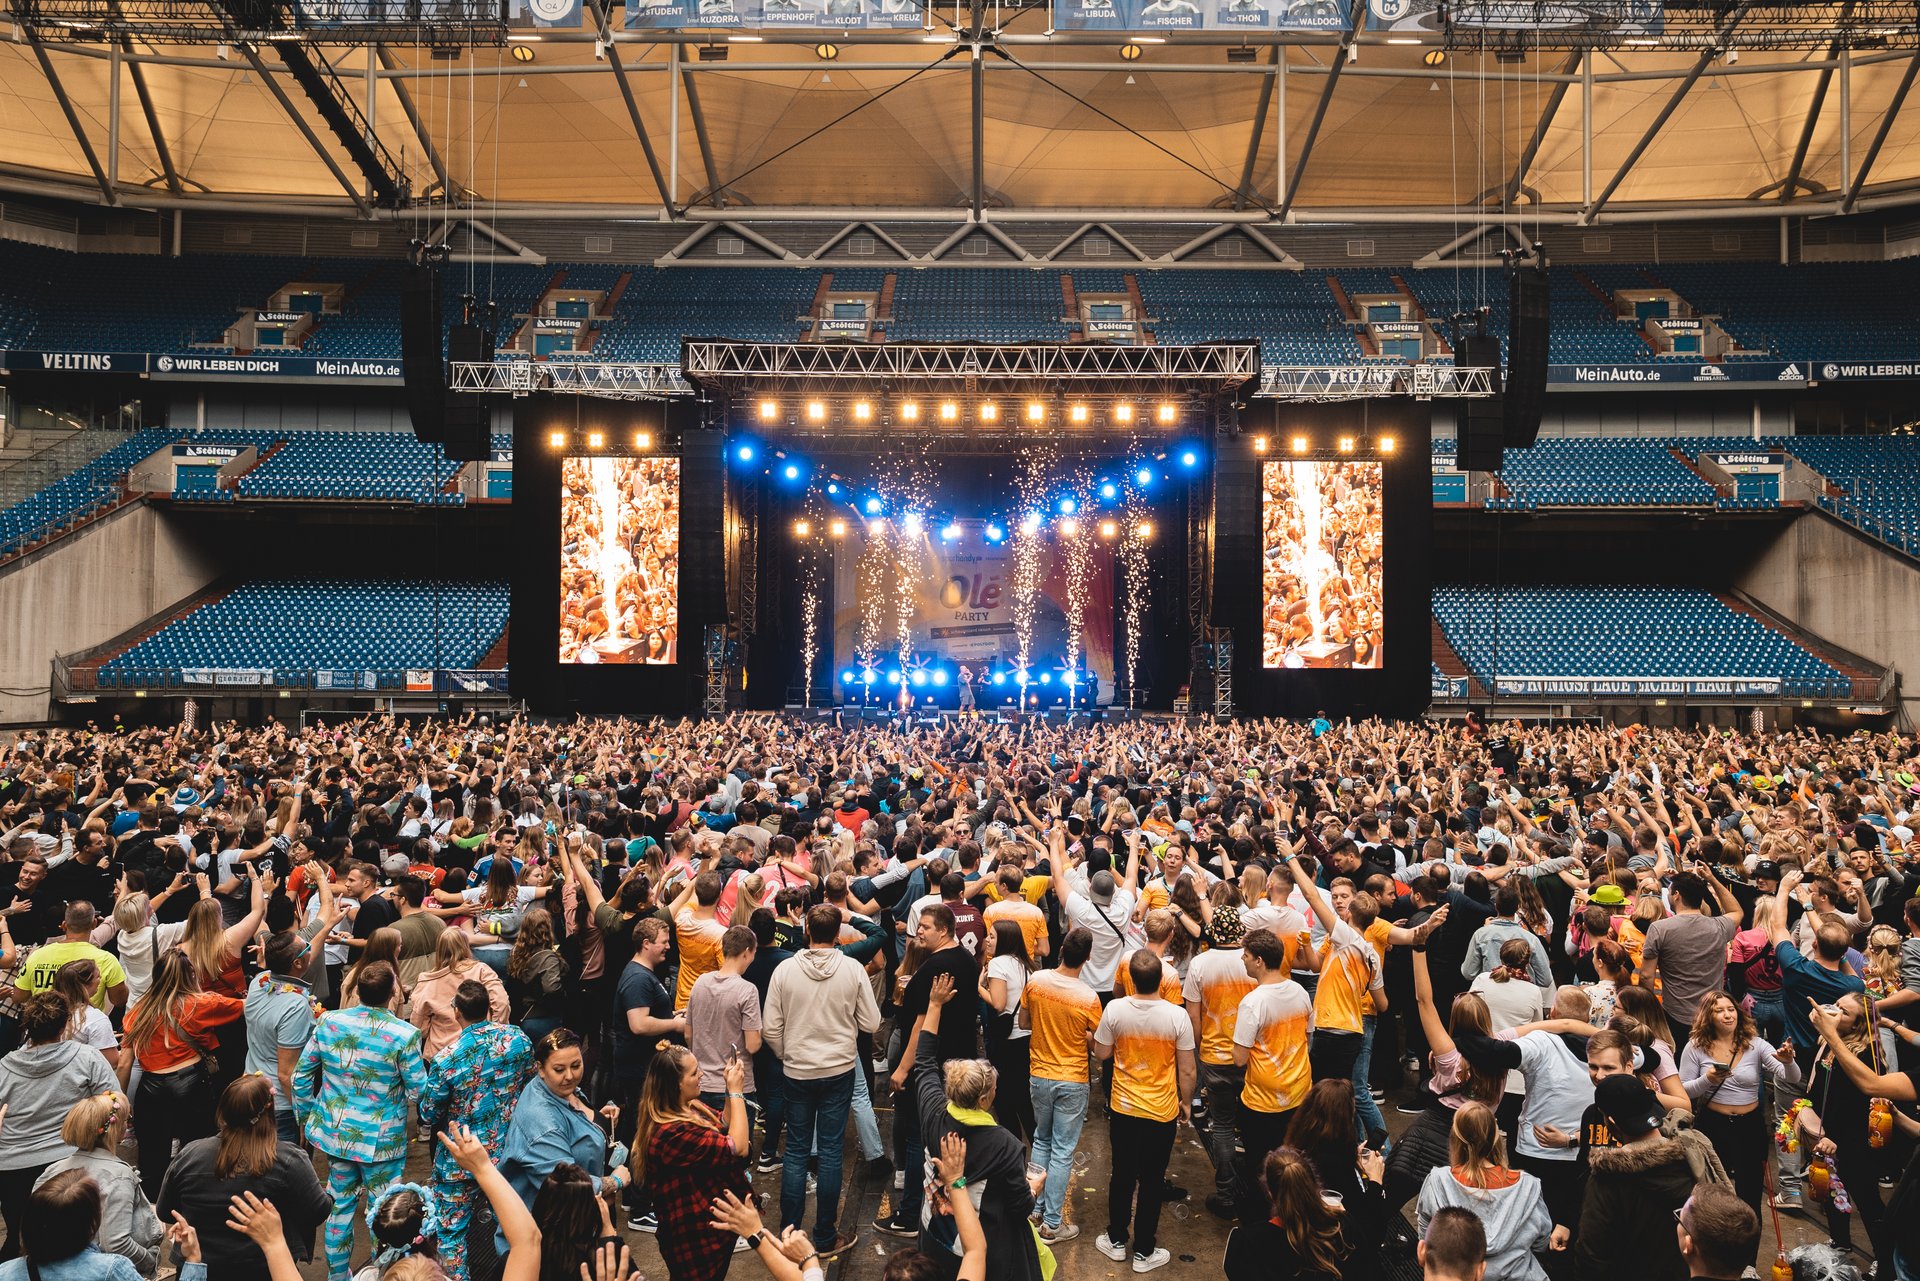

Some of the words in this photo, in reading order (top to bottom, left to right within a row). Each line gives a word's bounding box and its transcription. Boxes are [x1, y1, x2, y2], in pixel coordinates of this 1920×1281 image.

[646, 7, 683, 16] STUDENT
[1383, 4, 1398, 13] 04
[766, 13, 815, 21] EPPENHOFF
[893, 13, 921, 22] KREUZ
[1085, 10, 1116, 18] LIBUDA
[1237, 14, 1261, 22] THON
[701, 15, 739, 23] KUZORRA
[835, 17, 862, 25] KLODT
[1157, 17, 1192, 25] FISCHER
[1300, 17, 1342, 26] WALDOCH
[545, 319, 581, 328] Stölting
[830, 321, 865, 330] Stölting
[1097, 322, 1133, 331] Stölting
[1383, 324, 1419, 332] Stölting
[1662, 320, 1699, 328] Stölting
[42, 353, 111, 371] VELTINS
[175, 359, 201, 370] WIR
[203, 360, 245, 371] LEBEN
[247, 361, 279, 372] DICH
[316, 361, 400, 376] MeinAuto.de
[1841, 365, 1868, 376] WIR
[1869, 365, 1912, 376] LEBEN
[1576, 367, 1660, 381] MeinAuto.de
[196, 447, 237, 456] Stölting
[1728, 455, 1769, 464] Stölting
[940, 573, 1001, 609] Olé
[954, 610, 989, 622] PARTY
[955, 914, 975, 923] KURVE
